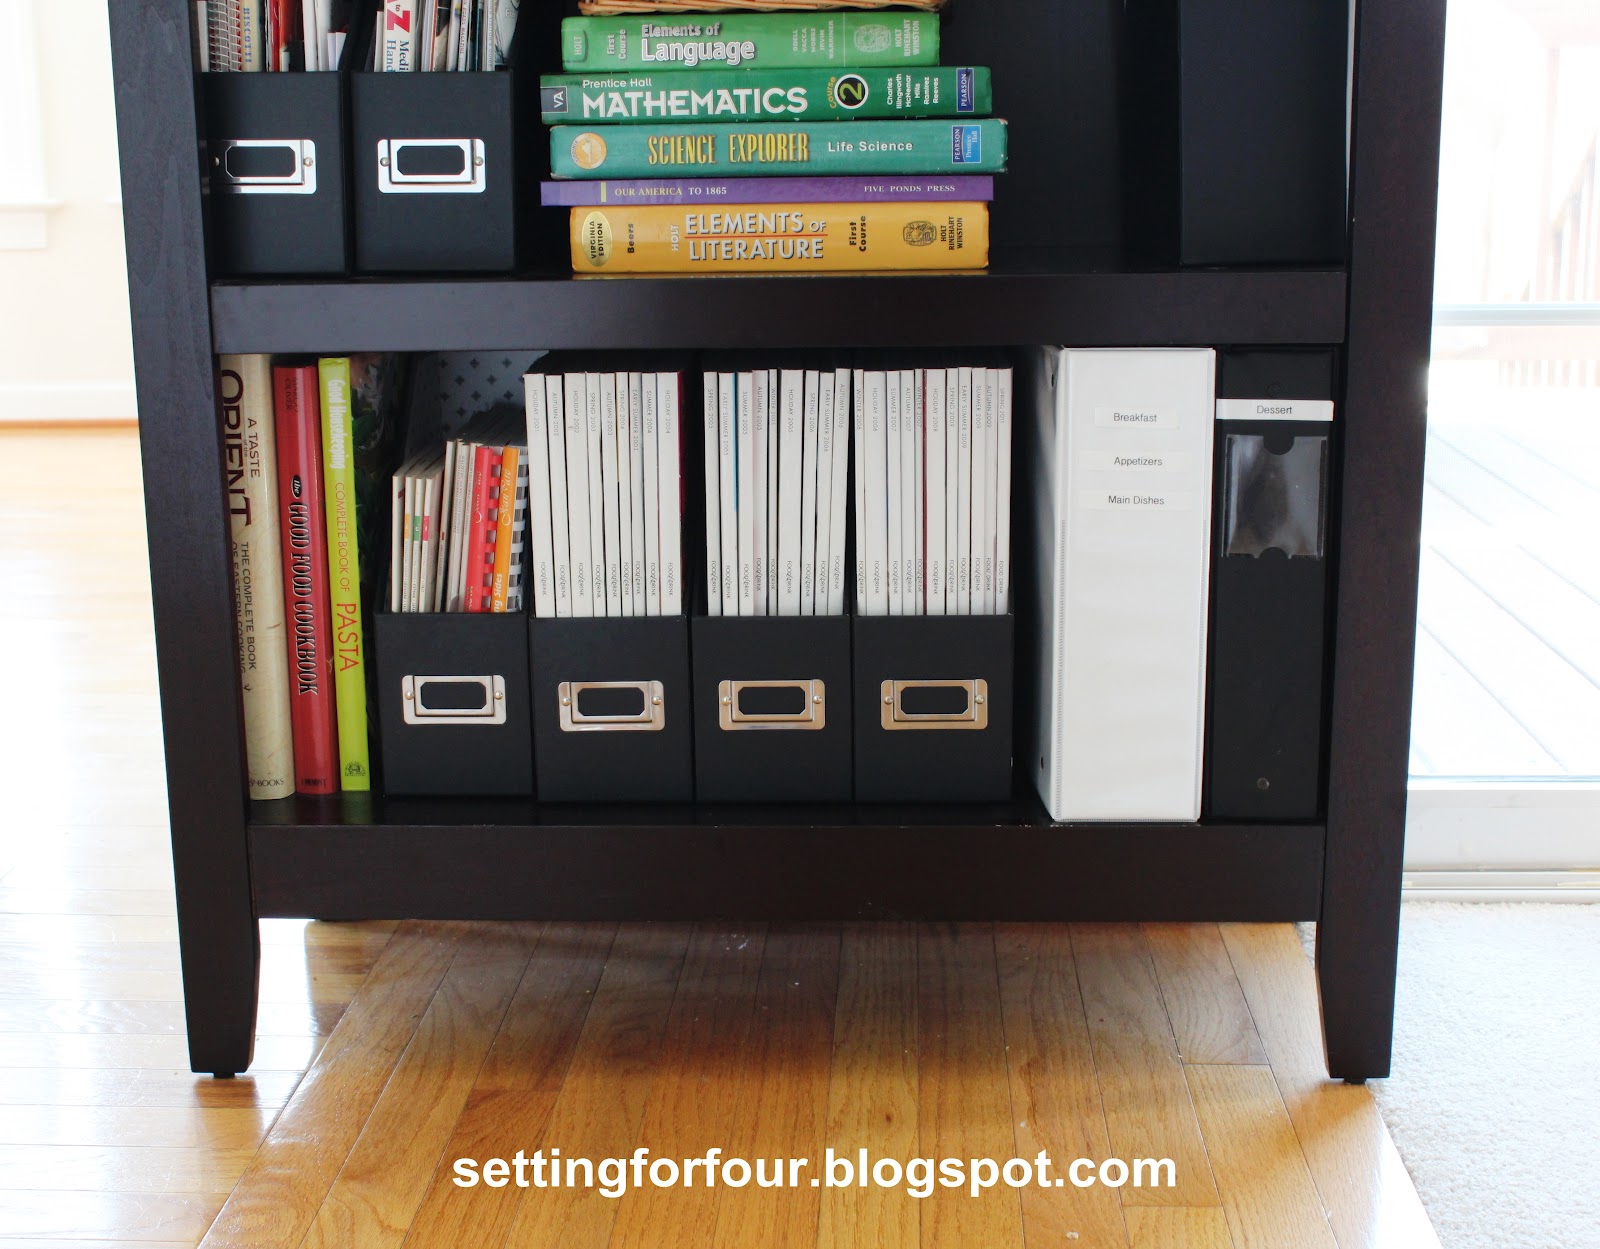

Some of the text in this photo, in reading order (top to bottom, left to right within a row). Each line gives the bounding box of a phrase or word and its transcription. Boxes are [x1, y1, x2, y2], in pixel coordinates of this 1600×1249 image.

[387, 9, 410, 33] Z
[641, 22, 720, 37] Elements of
[574, 36, 582, 55] HOLT
[607, 34, 615, 55] First
[619, 29, 627, 59] Course
[641, 38, 755, 66] Language
[583, 78, 652, 88] Prentice Hall
[826, 76, 837, 109] Course
[839, 82, 862, 101] 2
[554, 91, 564, 108] VA
[582, 87, 808, 118] MATHEMATICS
[648, 133, 809, 165] SCIENCE EXPLORER
[828, 141, 913, 152] Life Science
[615, 186, 727, 196] OUR AMERICA TO 1865
[685, 212, 827, 235] ELEMENTS OF
[849, 221, 857, 246] First
[627, 224, 635, 253] Beers
[671, 224, 680, 250] HOLT
[689, 238, 824, 261] LITERATURE
[1113, 413, 1157, 423] Breakfast
[1257, 405, 1293, 415] Dessert
[327, 379, 349, 469] Good Housekeeping
[221, 369, 252, 527] ORIENT
[247, 418, 260, 478] A TASTE
[1114, 457, 1163, 467] Appetizers
[1108, 495, 1165, 505] Main Dishes
[288, 479, 319, 695] the GOOD FOOD COOKBOOK
[335, 482, 360, 672] COMPLETE BOOK OF PASTA
[493, 573, 503, 598] Sides
[240, 542, 256, 670] THE COMPLETE BOOK
[258, 778, 284, 786] BOOKS
